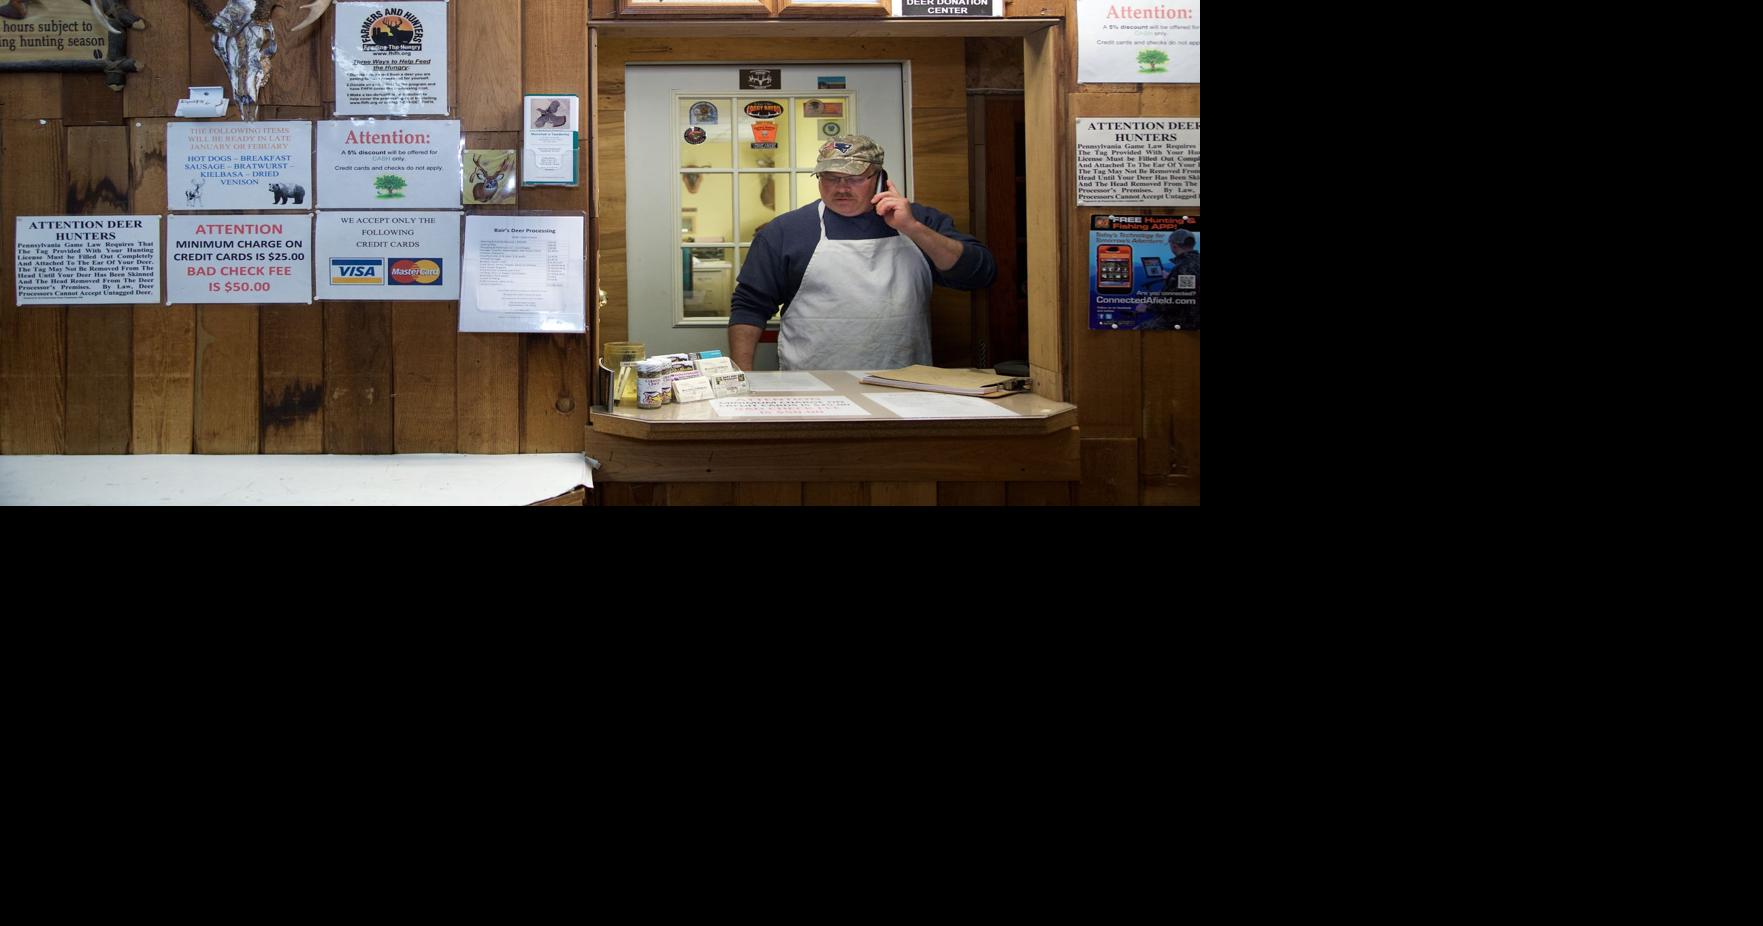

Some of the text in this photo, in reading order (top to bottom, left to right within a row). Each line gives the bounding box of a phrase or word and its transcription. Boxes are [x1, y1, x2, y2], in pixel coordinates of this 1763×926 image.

[1107, 5, 1192, 19] Attention:
[3, 20, 93, 35] hours subject to
[361, 8, 423, 43] FARMERS AND HUNTERS
[20, 35, 64, 51] hunting
[68, 37, 105, 46] season
[1088, 122, 1164, 130] ATTENTION
[345, 130, 430, 144] Attention:
[1115, 133, 1177, 141] HUNTERS
[29, 220, 143, 229] ATTENTION DEER
[1144, 217, 1185, 225] Hunting
[195, 224, 283, 234] ATTENTION
[56, 232, 116, 240] HUNTERS
[285, 240, 302, 248] ON
[174, 253, 213, 261] CREDIT
[216, 253, 252, 261] CARDS
[187, 266, 292, 276] BAD CHECK FEE
[339, 266, 440, 276] VISA MasterCard
[209, 281, 270, 292] IS $50.00
[1096, 296, 1196, 305] ConnectedAfield.com
